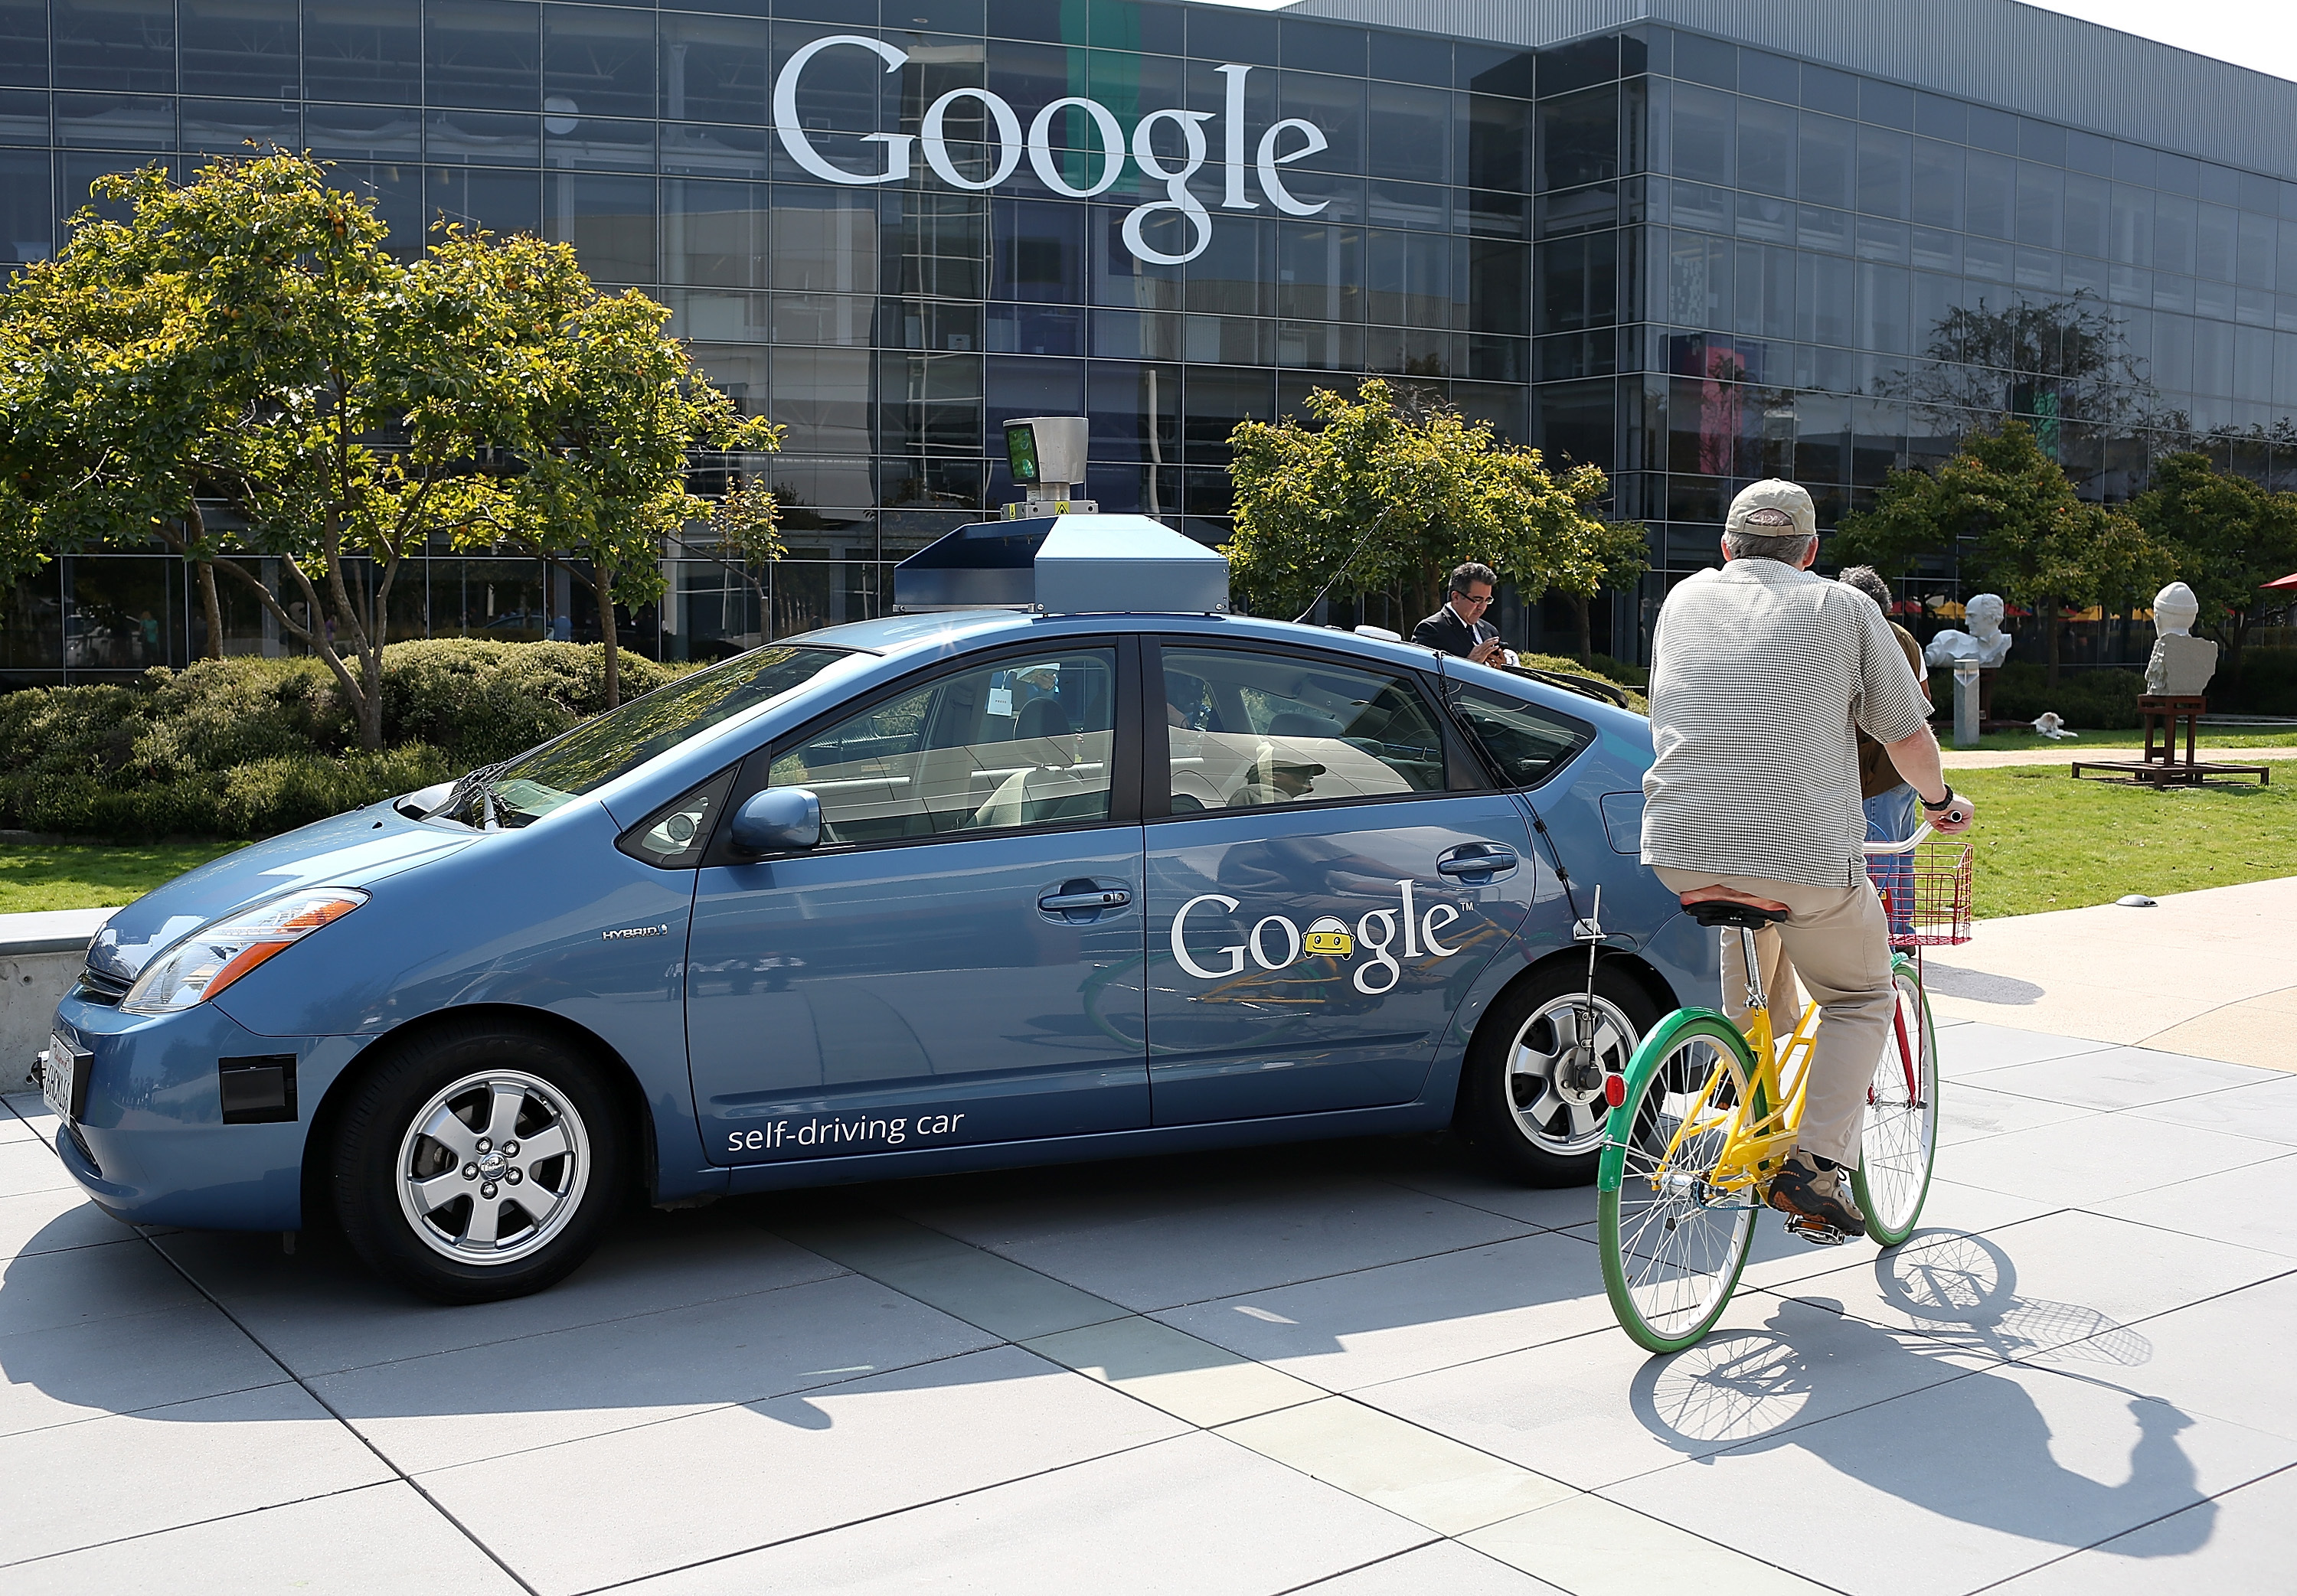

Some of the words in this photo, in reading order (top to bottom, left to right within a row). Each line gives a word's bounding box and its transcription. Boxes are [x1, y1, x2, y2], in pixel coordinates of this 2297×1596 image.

[773, 34, 1331, 266] Google
[603, 927, 657, 941] HYBRID
[1170, 879, 1462, 994] Gogle
[727, 1115, 908, 1151] self-driving
[917, 1113, 966, 1134] car
